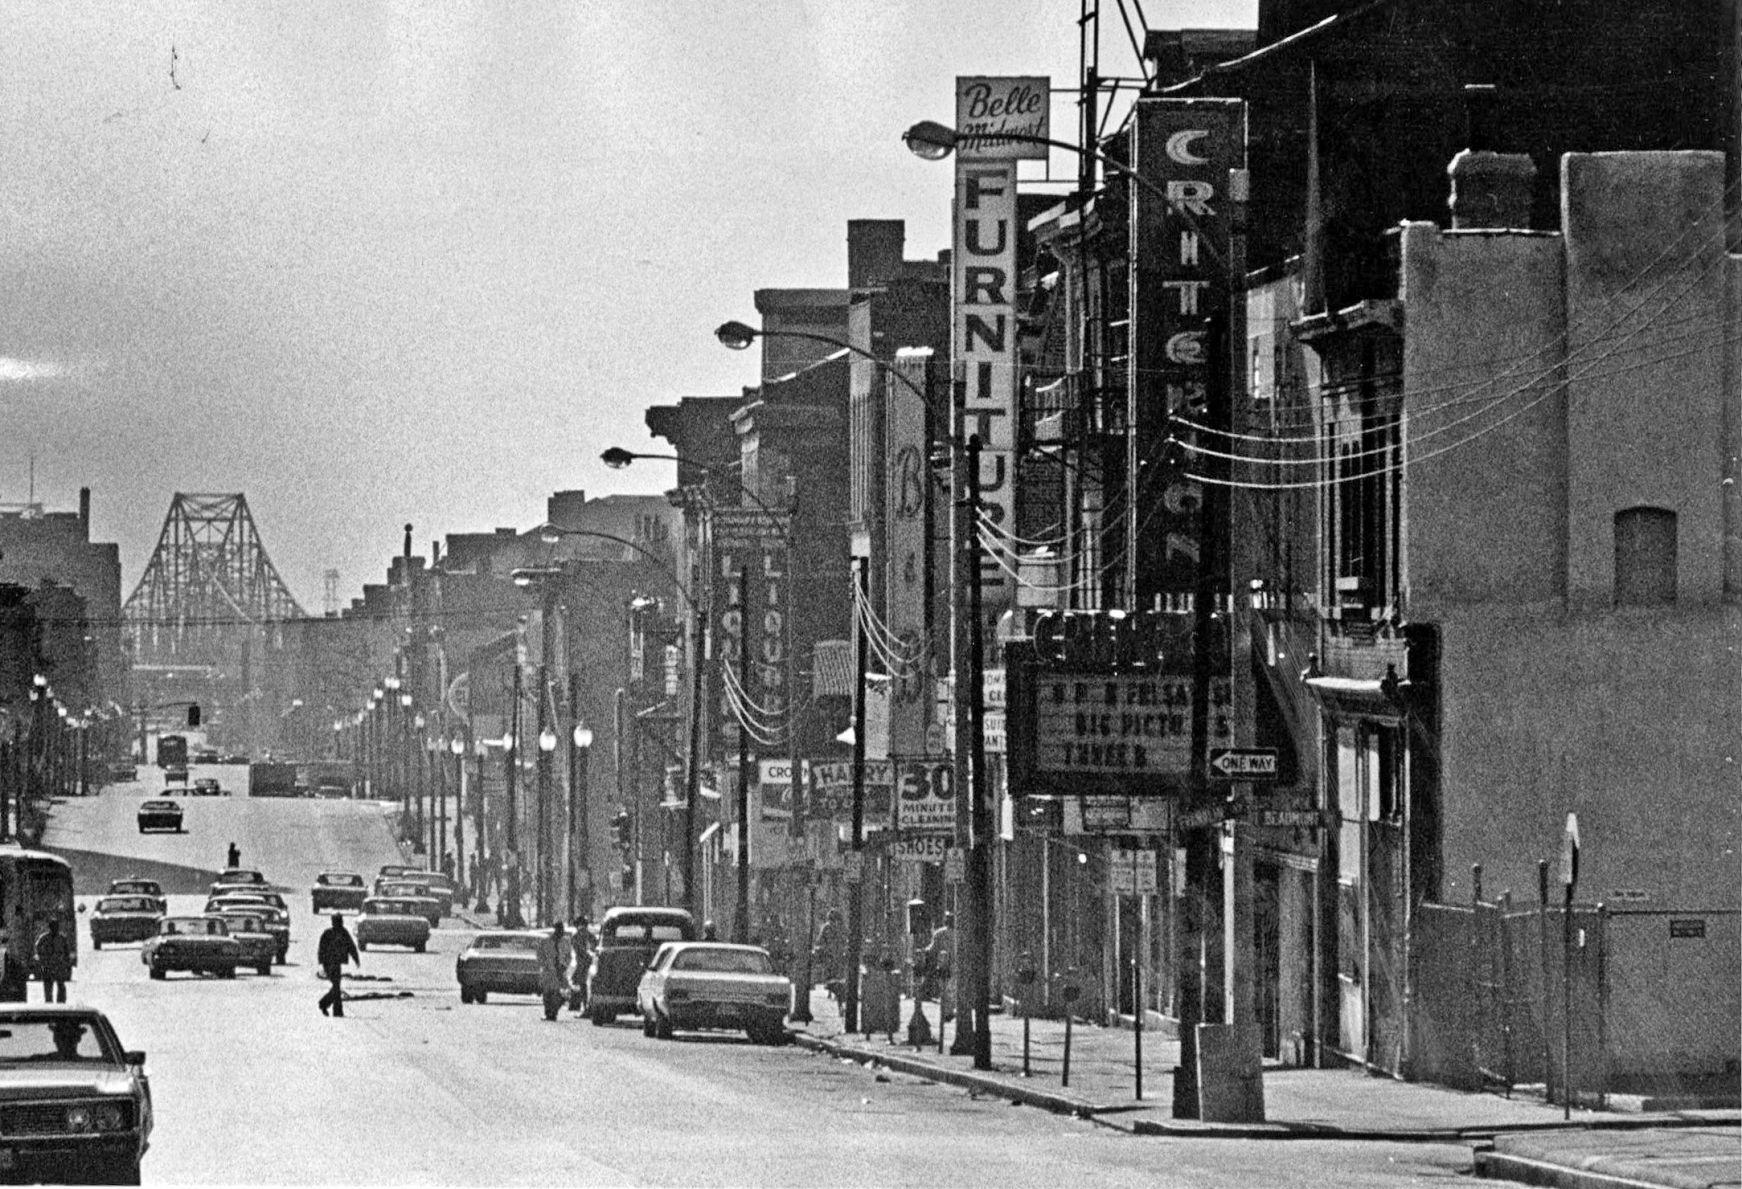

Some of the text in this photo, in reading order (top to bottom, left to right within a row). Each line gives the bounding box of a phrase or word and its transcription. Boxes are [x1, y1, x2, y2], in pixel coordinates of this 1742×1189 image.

[964, 82, 1042, 119] Belle
[768, 766, 808, 778] CRON
[1222, 756, 1273, 770] ONE WAY
[820, 764, 888, 785] HARY
[901, 763, 955, 801] 30
[903, 803, 954, 813] MINUTE
[897, 837, 943, 857] SHOES
